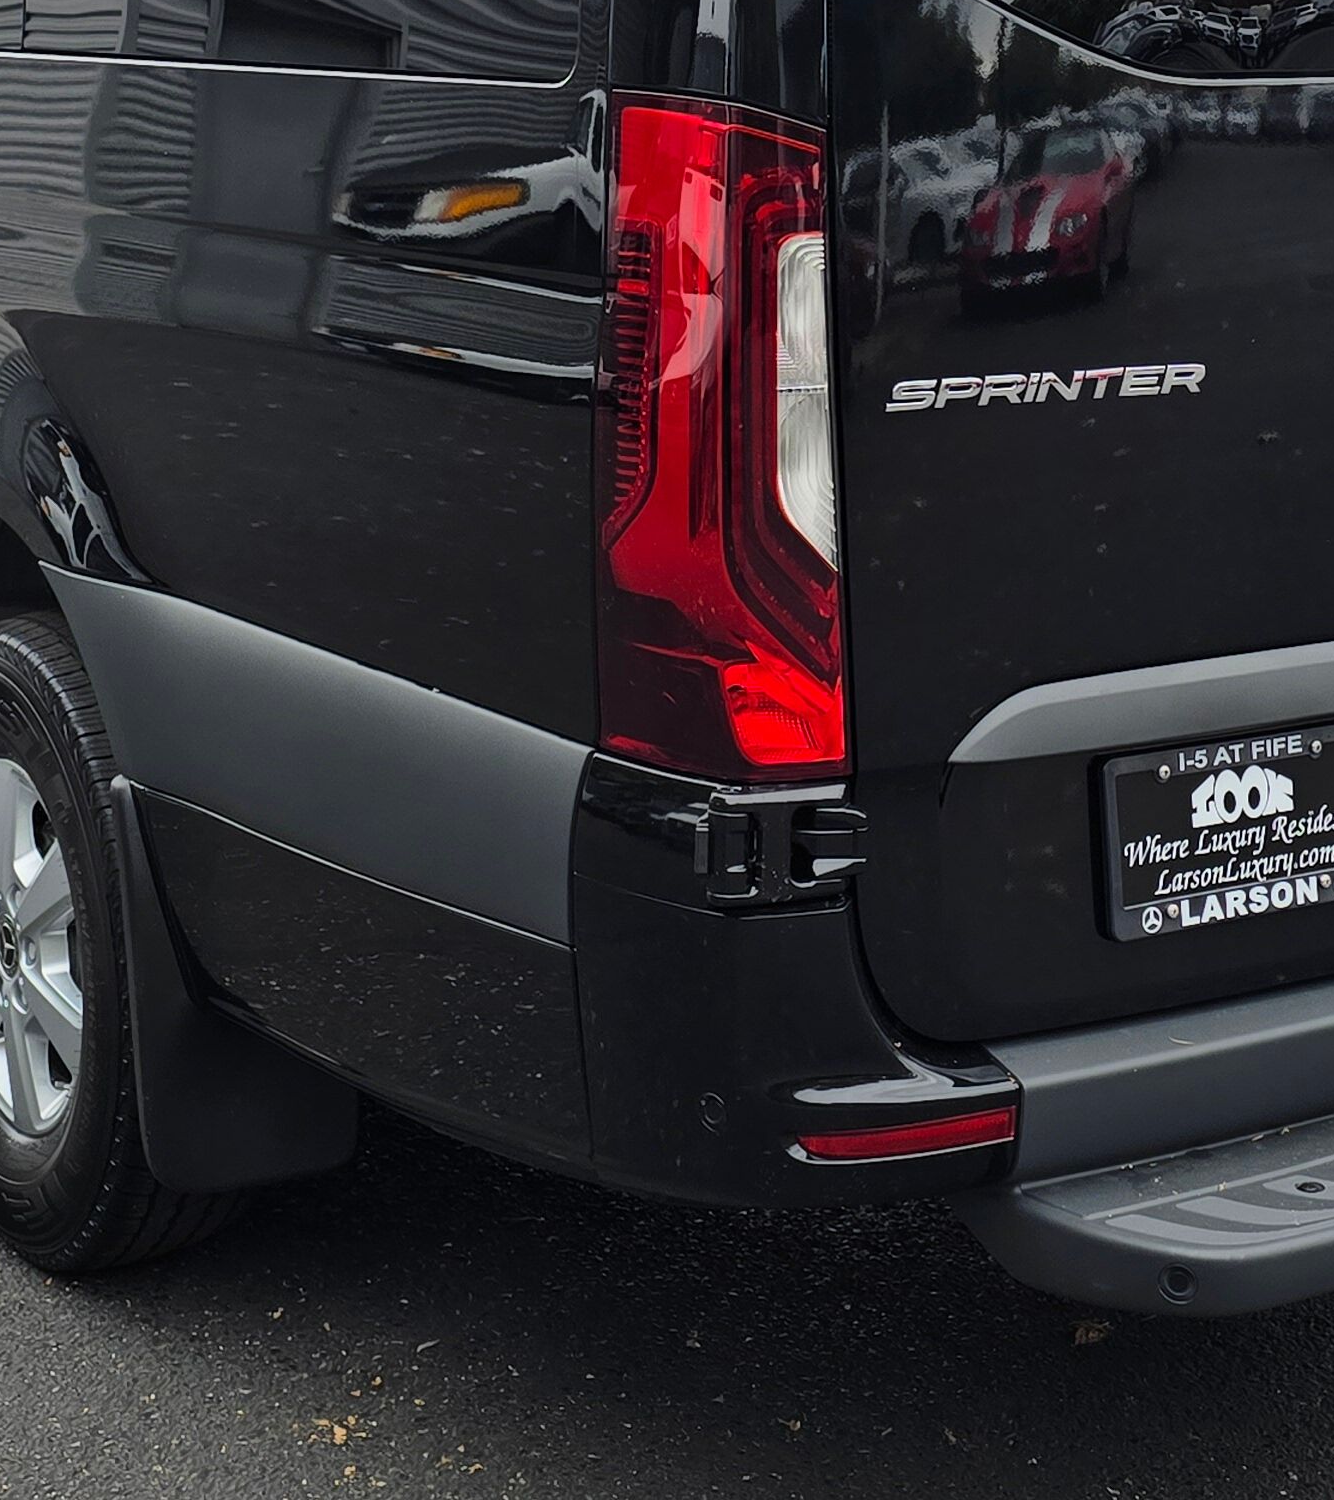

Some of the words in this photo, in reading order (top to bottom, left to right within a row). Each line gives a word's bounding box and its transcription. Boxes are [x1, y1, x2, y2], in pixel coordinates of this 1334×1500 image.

[885, 363, 1206, 413] SPRINTER
[1178, 749, 1208, 772] I-5
[1213, 743, 1244, 767] AT
[1251, 734, 1303, 760] FIFE
[1191, 764, 1295, 828] LOOK
[1124, 834, 1190, 868] Where
[1194, 824, 1266, 855] Luxury
[1180, 875, 1319, 928] LARSON
